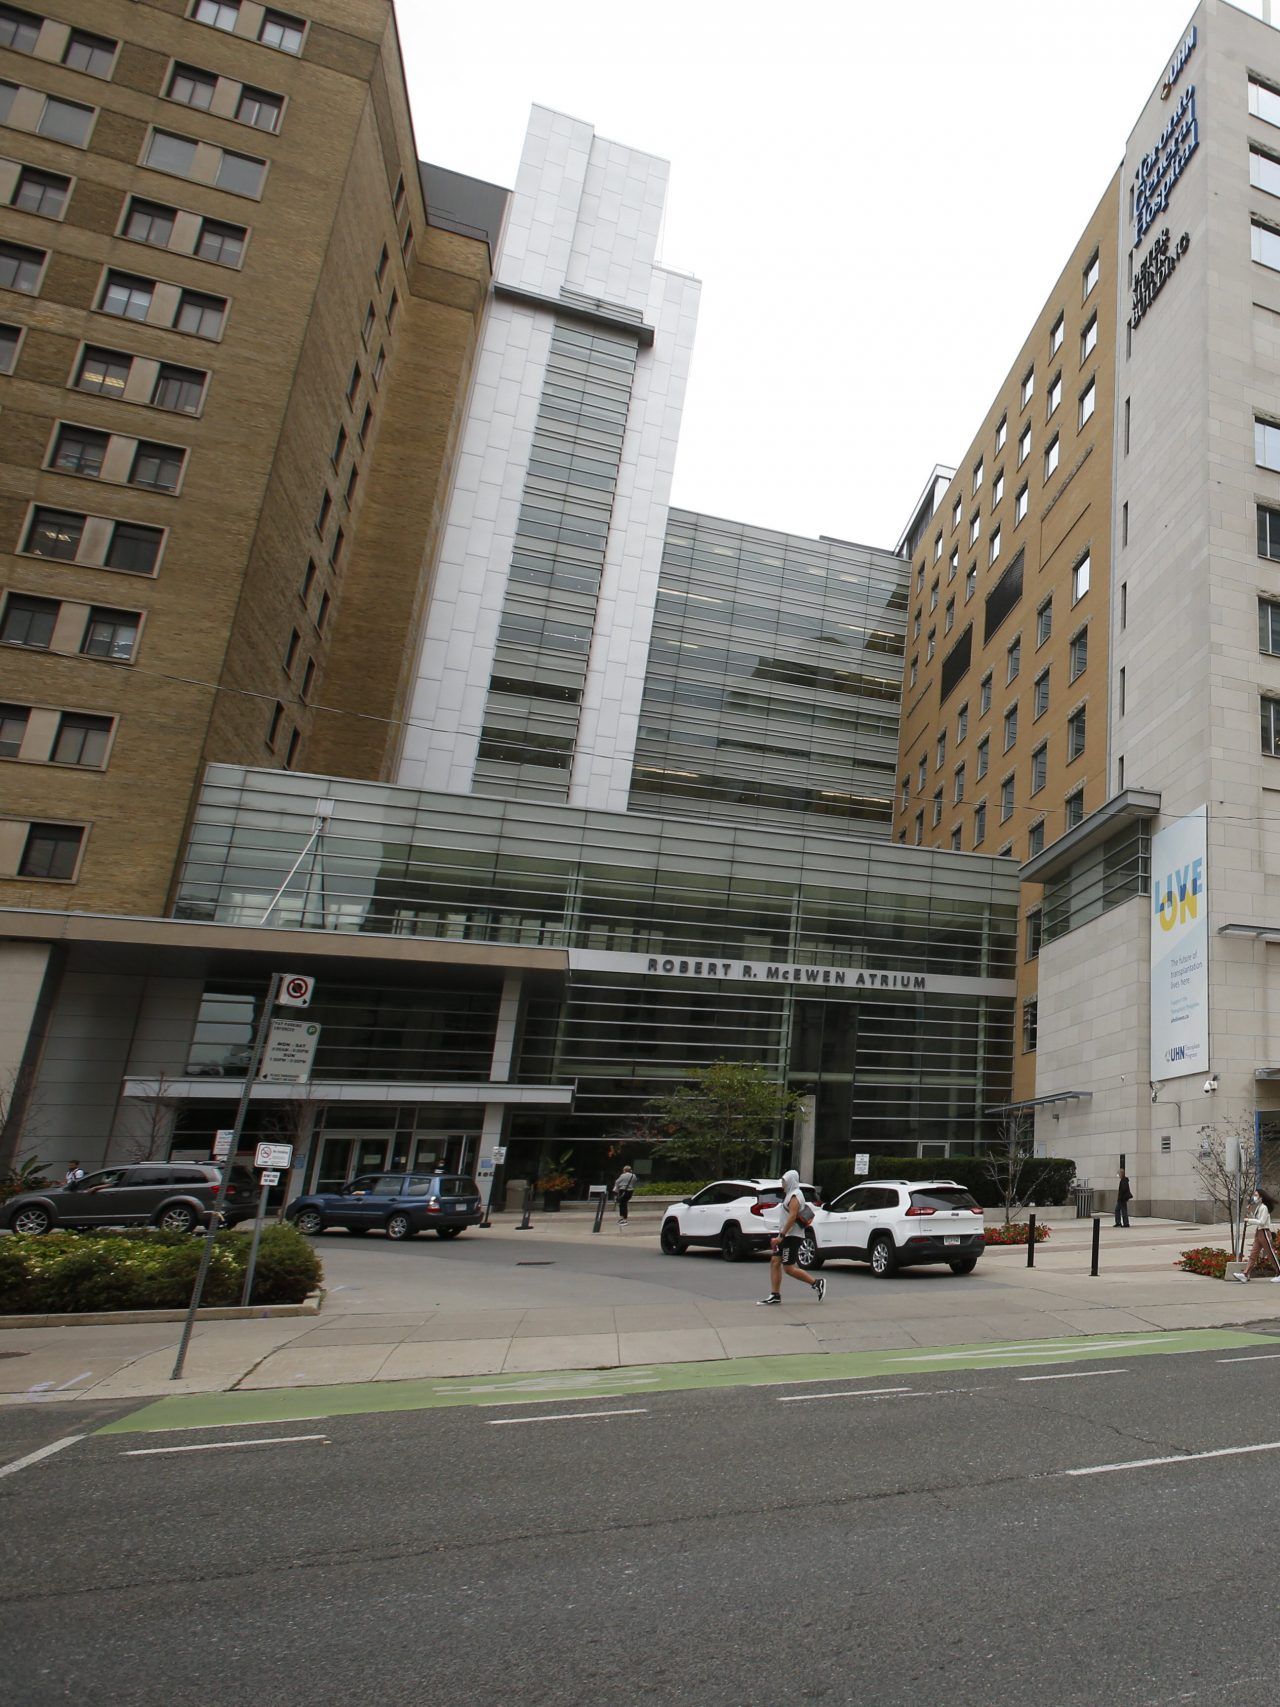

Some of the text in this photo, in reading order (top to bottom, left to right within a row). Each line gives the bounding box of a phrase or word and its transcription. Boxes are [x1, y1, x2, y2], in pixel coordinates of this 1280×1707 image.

[1169, 25, 1198, 86] UHN
[1134, 98, 1198, 216] General
[1135, 84, 1196, 190] Toronto
[1133, 120, 1200, 249] Hospital
[1154, 856, 1203, 915] LIVE
[1159, 889, 1198, 932] ON
[648, 958, 926, 990] ROBERT R. McEWEN ATRIUM
[1170, 959, 1179, 968] The
[1170, 1045, 1185, 1061] UHN
